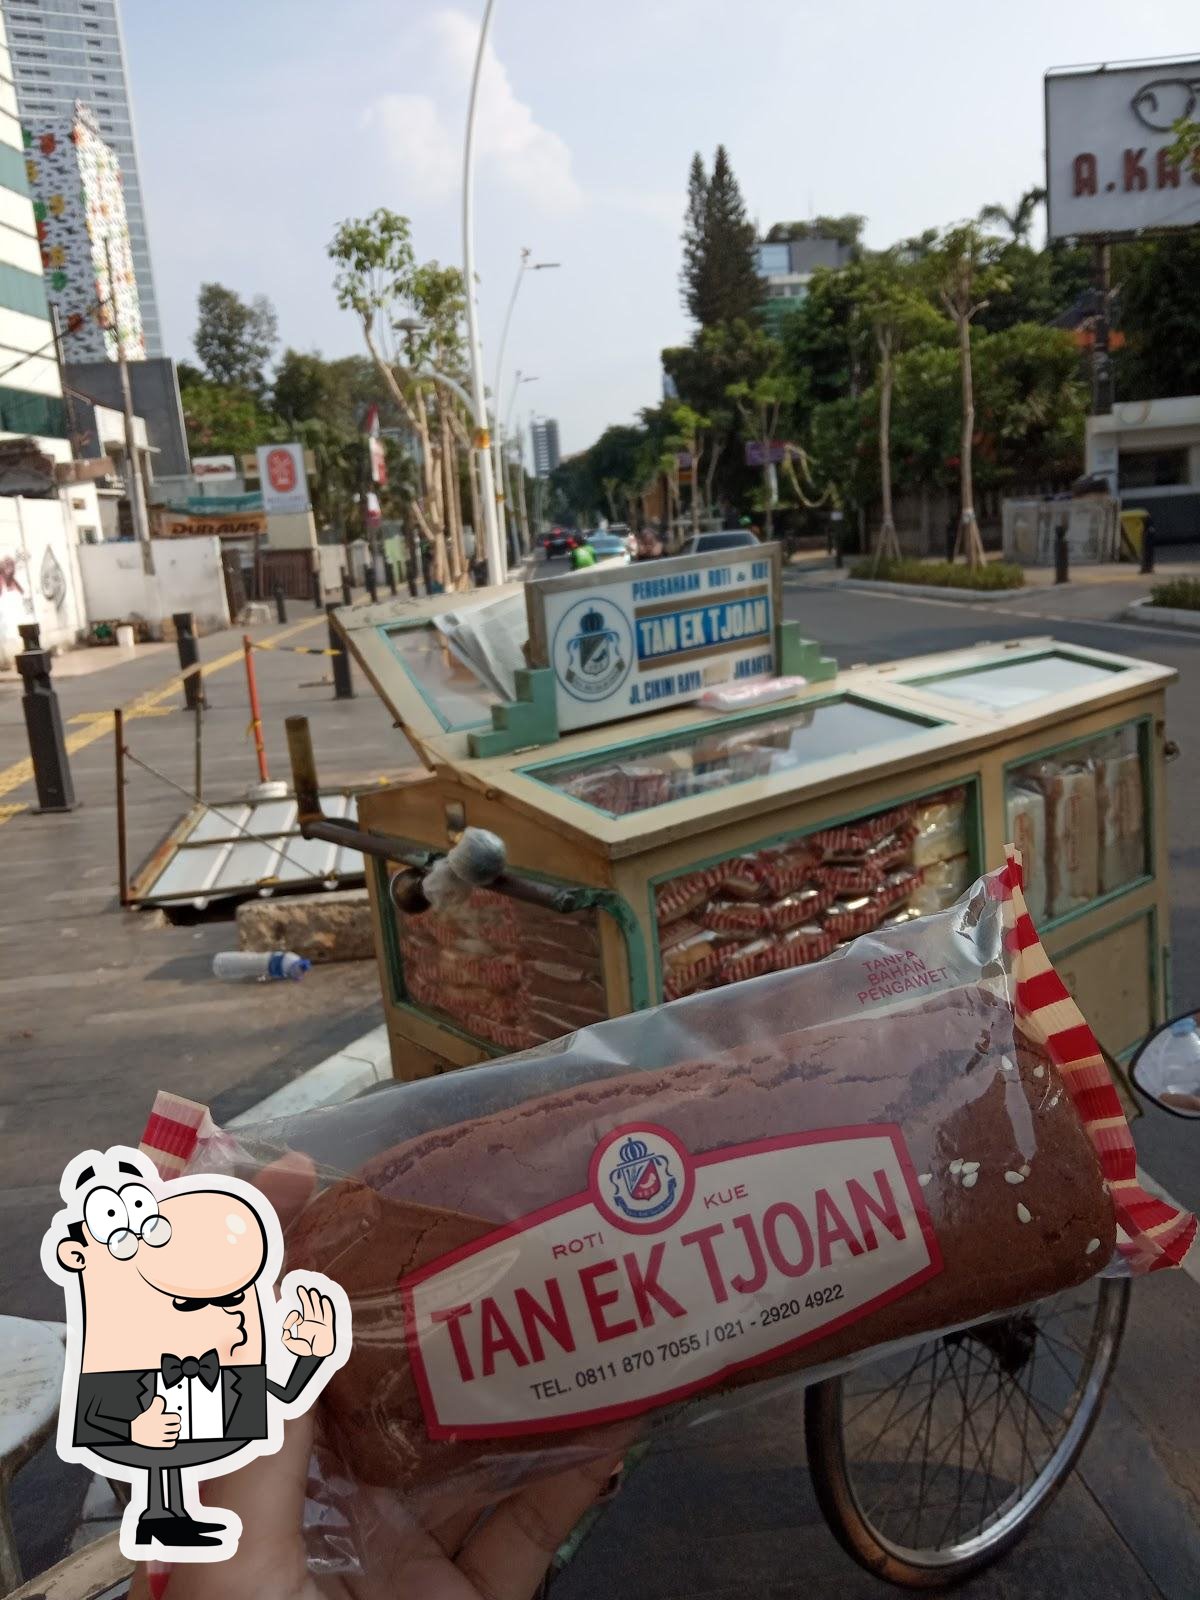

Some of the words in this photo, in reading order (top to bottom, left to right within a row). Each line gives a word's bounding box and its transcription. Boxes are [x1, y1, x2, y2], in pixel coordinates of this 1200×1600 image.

[632, 573, 700, 601] PERUSAHAAN
[708, 568, 731, 588] ROTI
[736, 572, 746, 582] &
[640, 616, 678, 656] TAN
[679, 610, 706, 648] EK
[708, 599, 767, 642] TJOAN
[678, 670, 701, 693] RAYA
[734, 654, 774, 680] JAKARTA
[862, 950, 918, 972] TANPA
[867, 959, 927, 986] BAHAN
[857, 967, 949, 1005] PENGAWET
[551, 1232, 605, 1260] ROTI
[703, 1184, 749, 1209] KUE
[430, 1277, 577, 1383] TAN
[577, 1241, 688, 1343] EK
[680, 1168, 907, 1304] TJOAN
[530, 1379, 572, 1401] TEL.
[575, 1364, 617, 1389] 0811
[622, 1350, 655, 1374] 870
[657, 1334, 702, 1363] 7055
[704, 1332, 711, 1347] /
[715, 1319, 746, 1343] 021
[760, 1298, 801, 1327] 2920
[805, 1284, 845, 1310] 4922
